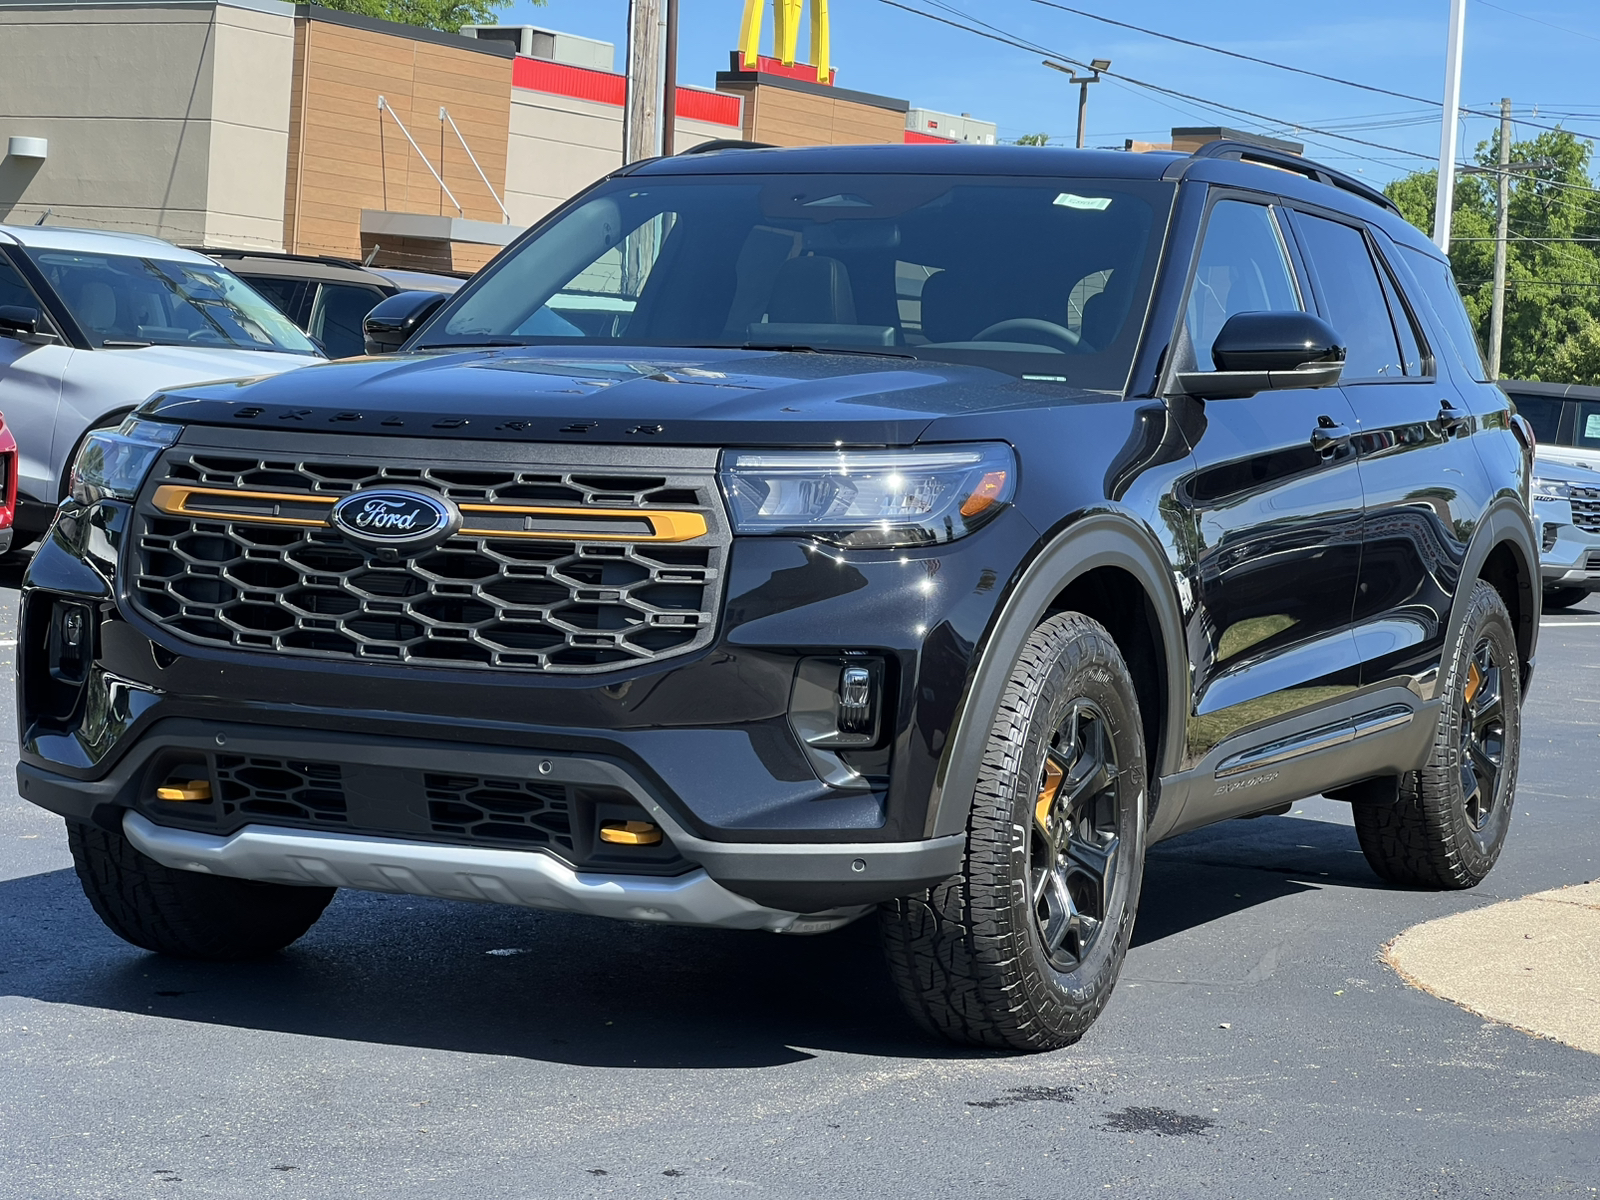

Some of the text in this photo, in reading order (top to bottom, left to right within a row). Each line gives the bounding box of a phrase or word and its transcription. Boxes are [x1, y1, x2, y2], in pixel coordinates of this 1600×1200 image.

[233, 407, 664, 435] EXPLORER
[356, 499, 420, 530] Ford
[1213, 771, 1280, 796] EXPLORER
